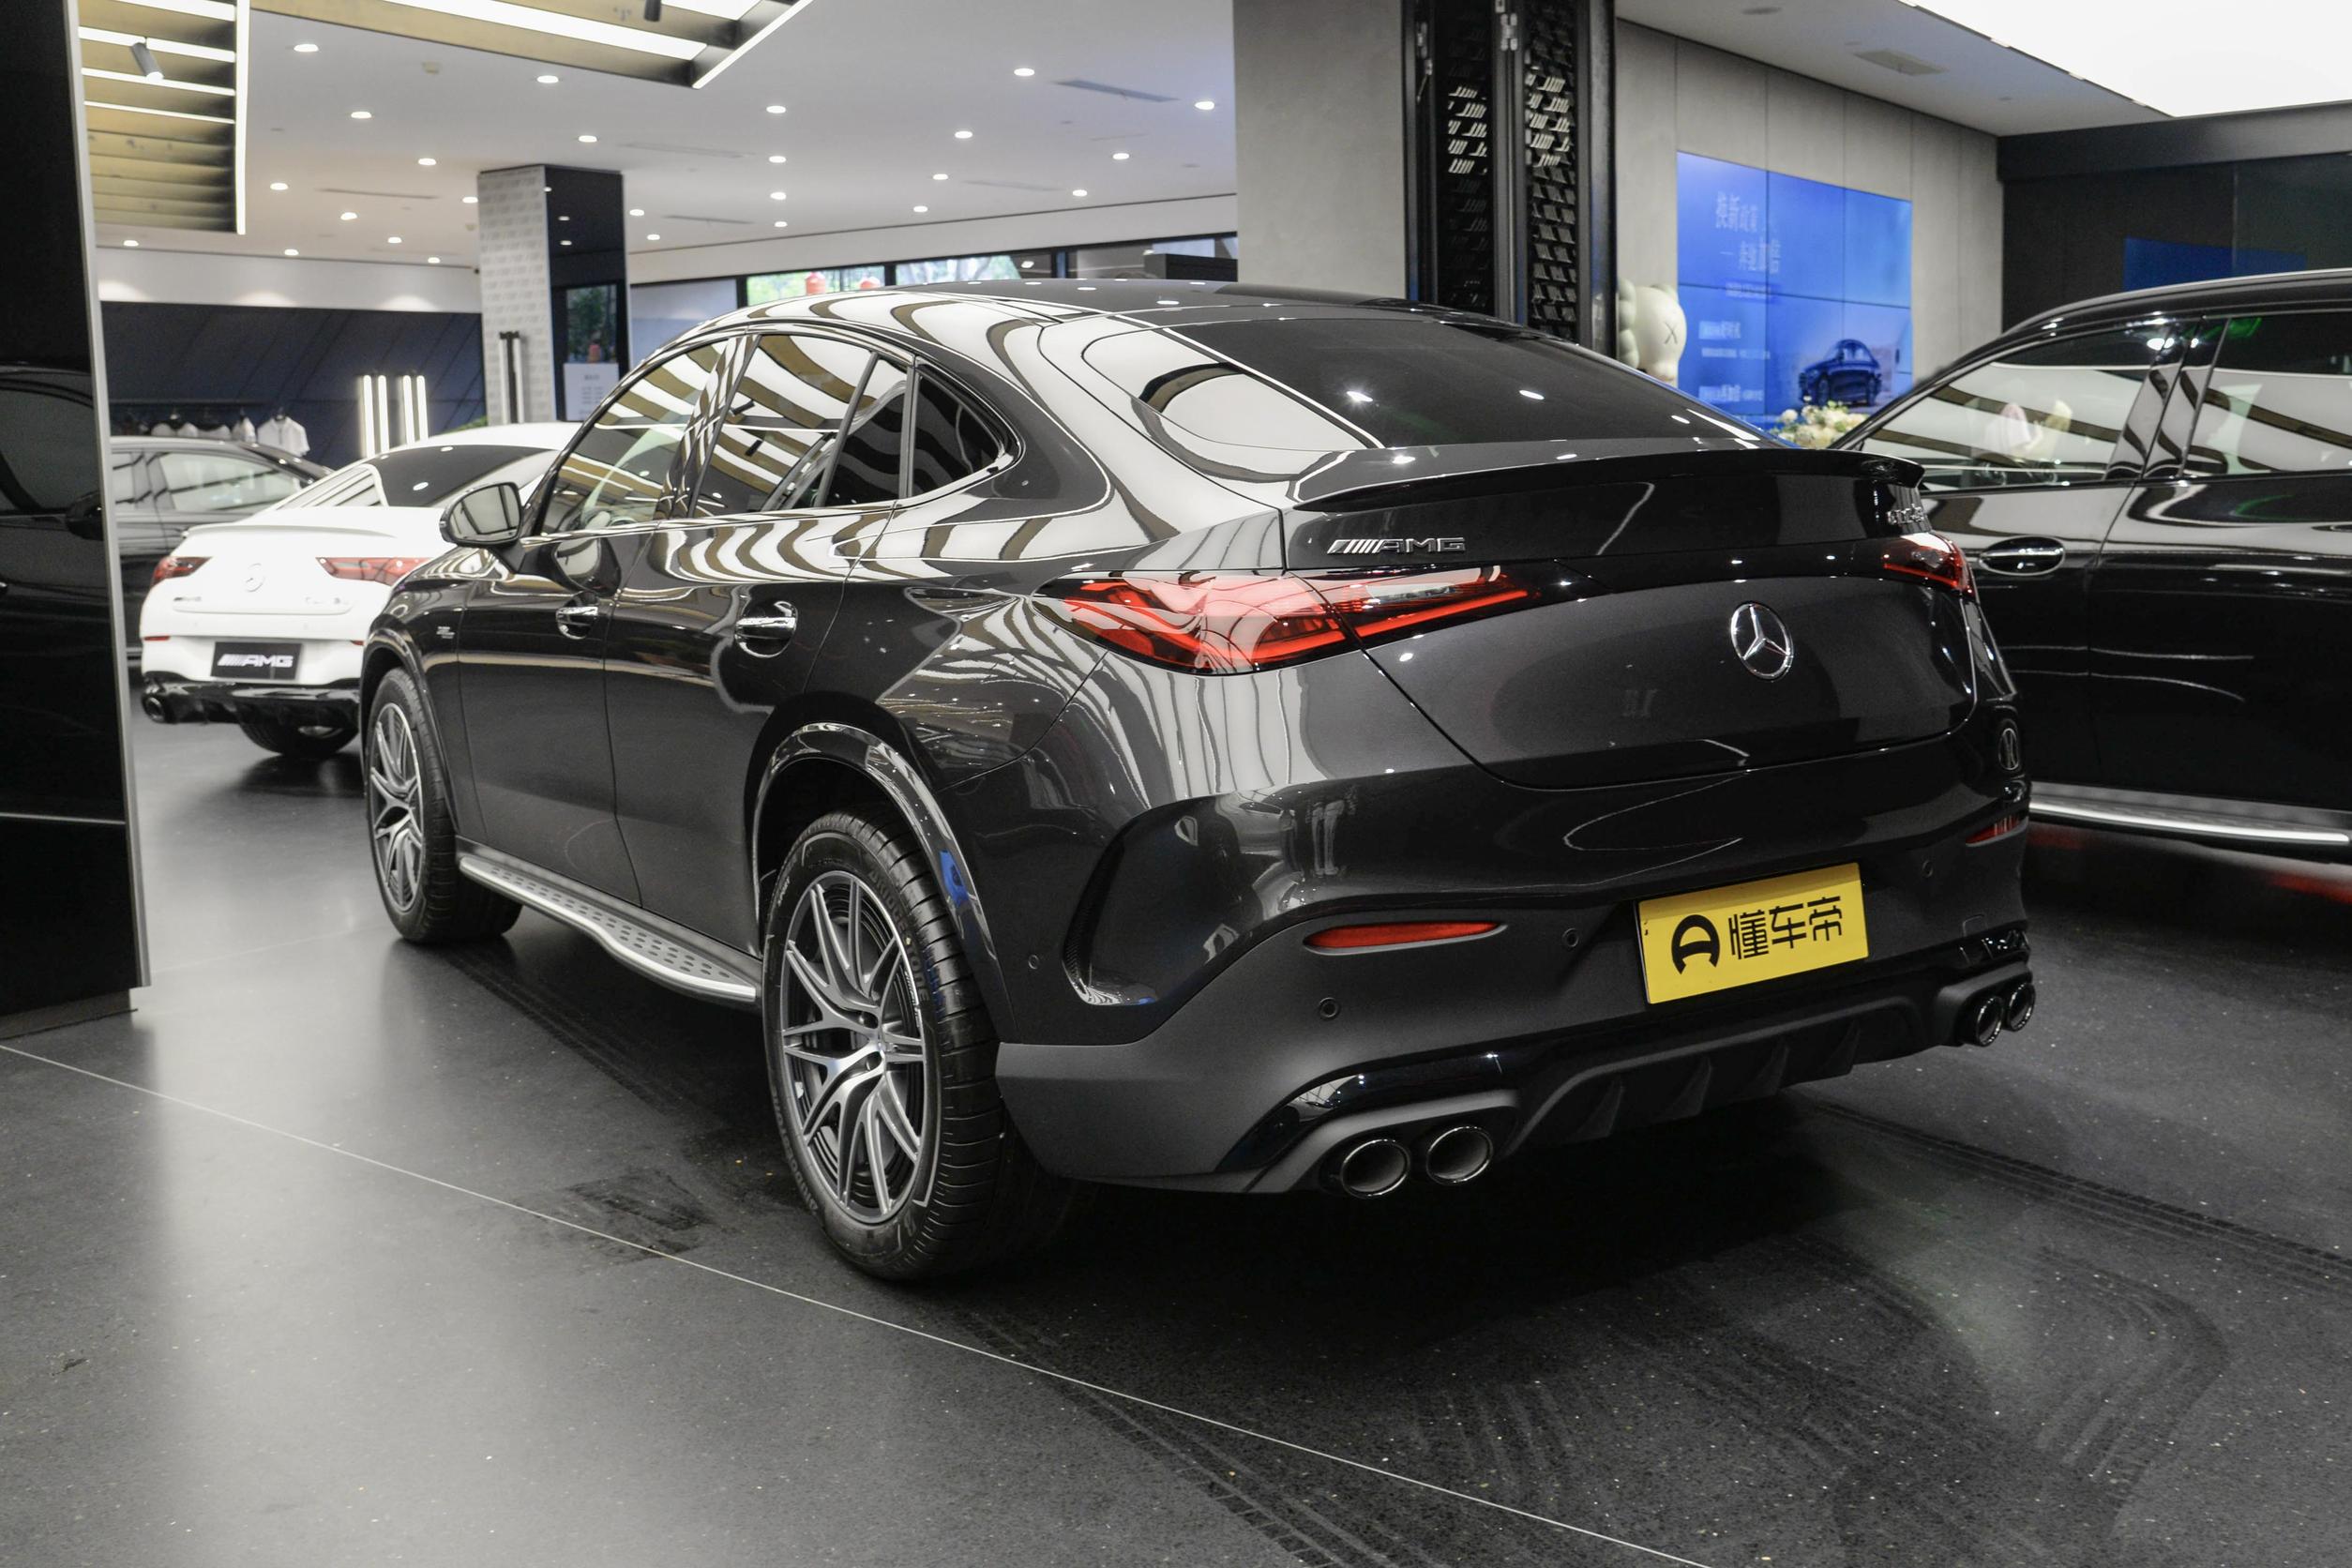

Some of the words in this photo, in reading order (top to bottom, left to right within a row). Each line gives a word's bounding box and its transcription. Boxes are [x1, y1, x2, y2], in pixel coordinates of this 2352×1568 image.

[1372, 537, 1466, 553] AMG
[242, 654, 294, 668] AMG
[1727, 896, 1843, 960] 懂车帝
